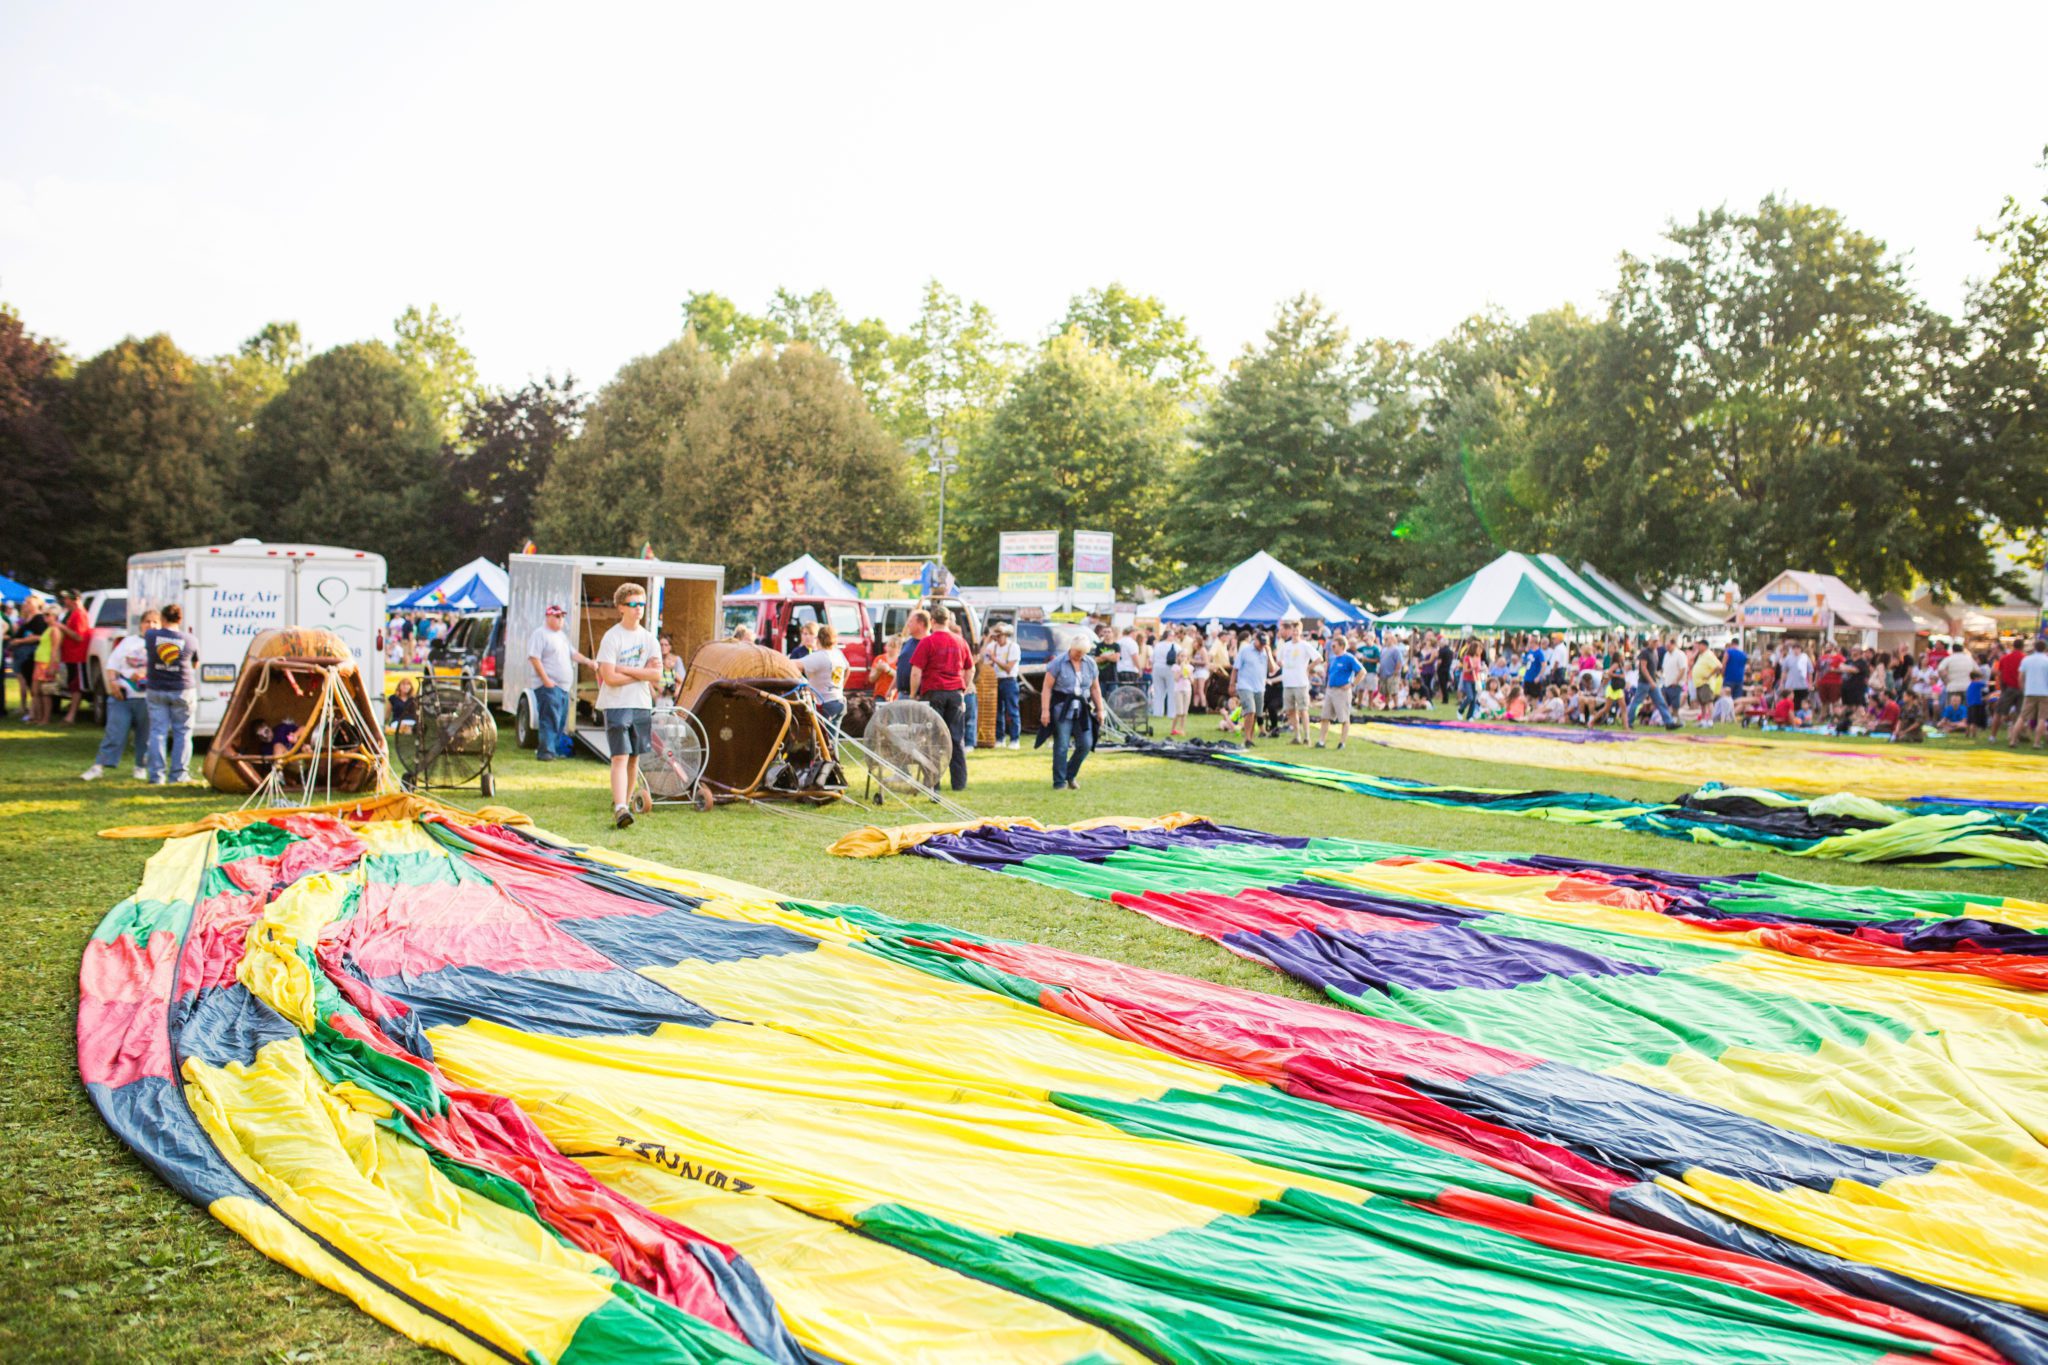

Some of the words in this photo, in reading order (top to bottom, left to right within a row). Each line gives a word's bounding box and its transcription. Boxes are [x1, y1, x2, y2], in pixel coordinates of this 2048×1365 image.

[213, 590, 245, 602] Hot
[251, 590, 281, 602] Air
[210, 606, 276, 618] Balloon
[1782, 606, 1792, 616] ICE
[222, 624, 260, 636] Ride
